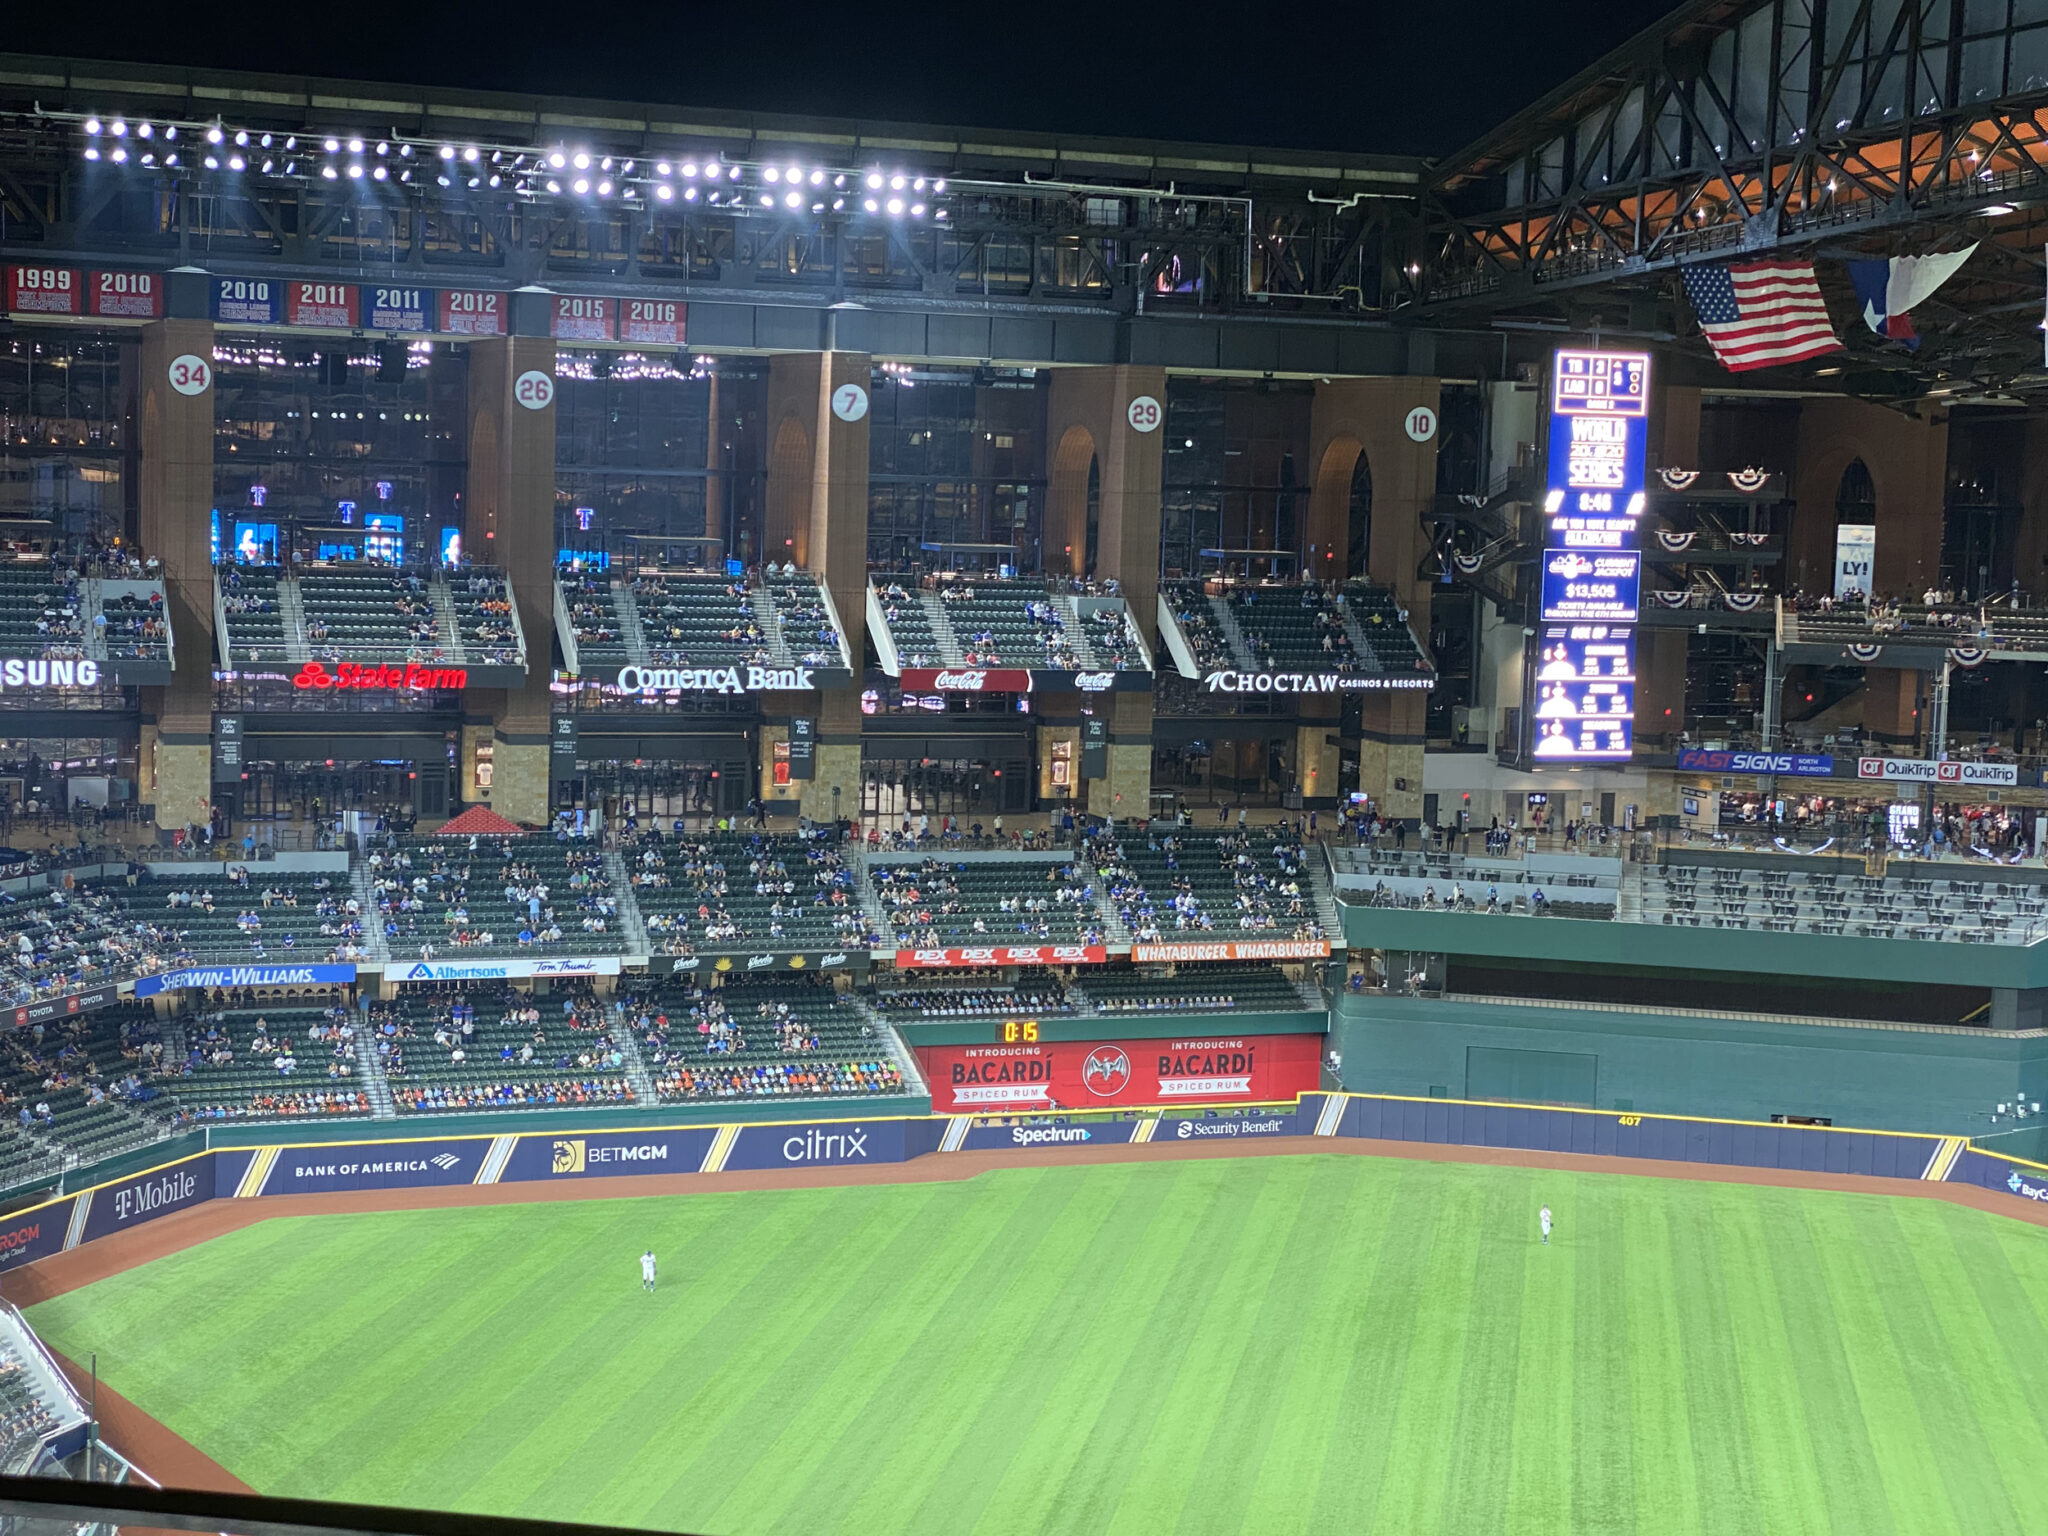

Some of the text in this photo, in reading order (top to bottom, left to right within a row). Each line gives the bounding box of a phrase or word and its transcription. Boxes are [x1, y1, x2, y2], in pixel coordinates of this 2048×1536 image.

[17, 268, 71, 290] 1999
[101, 273, 151, 294] 2010
[220, 280, 269, 301] 2010
[301, 284, 345, 305] 2011
[376, 289, 419, 309] 2011
[450, 292, 497, 313] 2012
[559, 298, 604, 318] 2015
[631, 302, 676, 322] 2016
[175, 364, 206, 387] 34
[519, 379, 549, 401] 26
[845, 393, 857, 413] 7
[1132, 404, 1157, 425] 29
[1412, 414, 1429, 434] 10
[1571, 419, 1627, 443] WORLD
[1569, 461, 1625, 485] SERIES
[1843, 562, 1868, 576] LY!
[1566, 583, 1616, 598] $13,505
[0, 660, 97, 686] SUNG
[335, 663, 467, 689] State Farm
[746, 666, 815, 690] Bank
[1219, 670, 1434, 693] CHOCTAW CASINOS & RESORTS
[1886, 762, 1936, 777] QuikTrip
[1963, 765, 2014, 781] QuikTrip
[914, 949, 948, 960] DEX
[961, 948, 995, 959] DEX
[1007, 947, 1040, 959] DEX
[1053, 946, 1086, 958] DEX
[1137, 943, 1325, 961] WHATABURGER WHATABURGER
[435, 966, 507, 978] Albertsons
[532, 959, 597, 973] Tom Thumb
[80, 994, 104, 1006] TOYOTA
[28, 1006, 54, 1019] TOYOTA
[1005, 1022, 1037, 1042] 0:15
[965, 1047, 1041, 1057] INTRODUCING
[1171, 1040, 1243, 1050] INTRODUCING
[952, 1052, 1053, 1084] BACARDÍ
[1158, 1046, 1255, 1076] BACARDÍ
[963, 1088, 1039, 1099] SPICED RUM
[1168, 1081, 1241, 1091] SPICED RUM
[1195, 1120, 1280, 1136] Security Benefit
[1618, 1116, 1641, 1126] 407
[783, 1127, 867, 1162] citrix
[1012, 1127, 1085, 1146] Spectrum
[588, 1145, 667, 1163] BETMGM
[295, 1160, 427, 1177] BANK OF AMERICA
